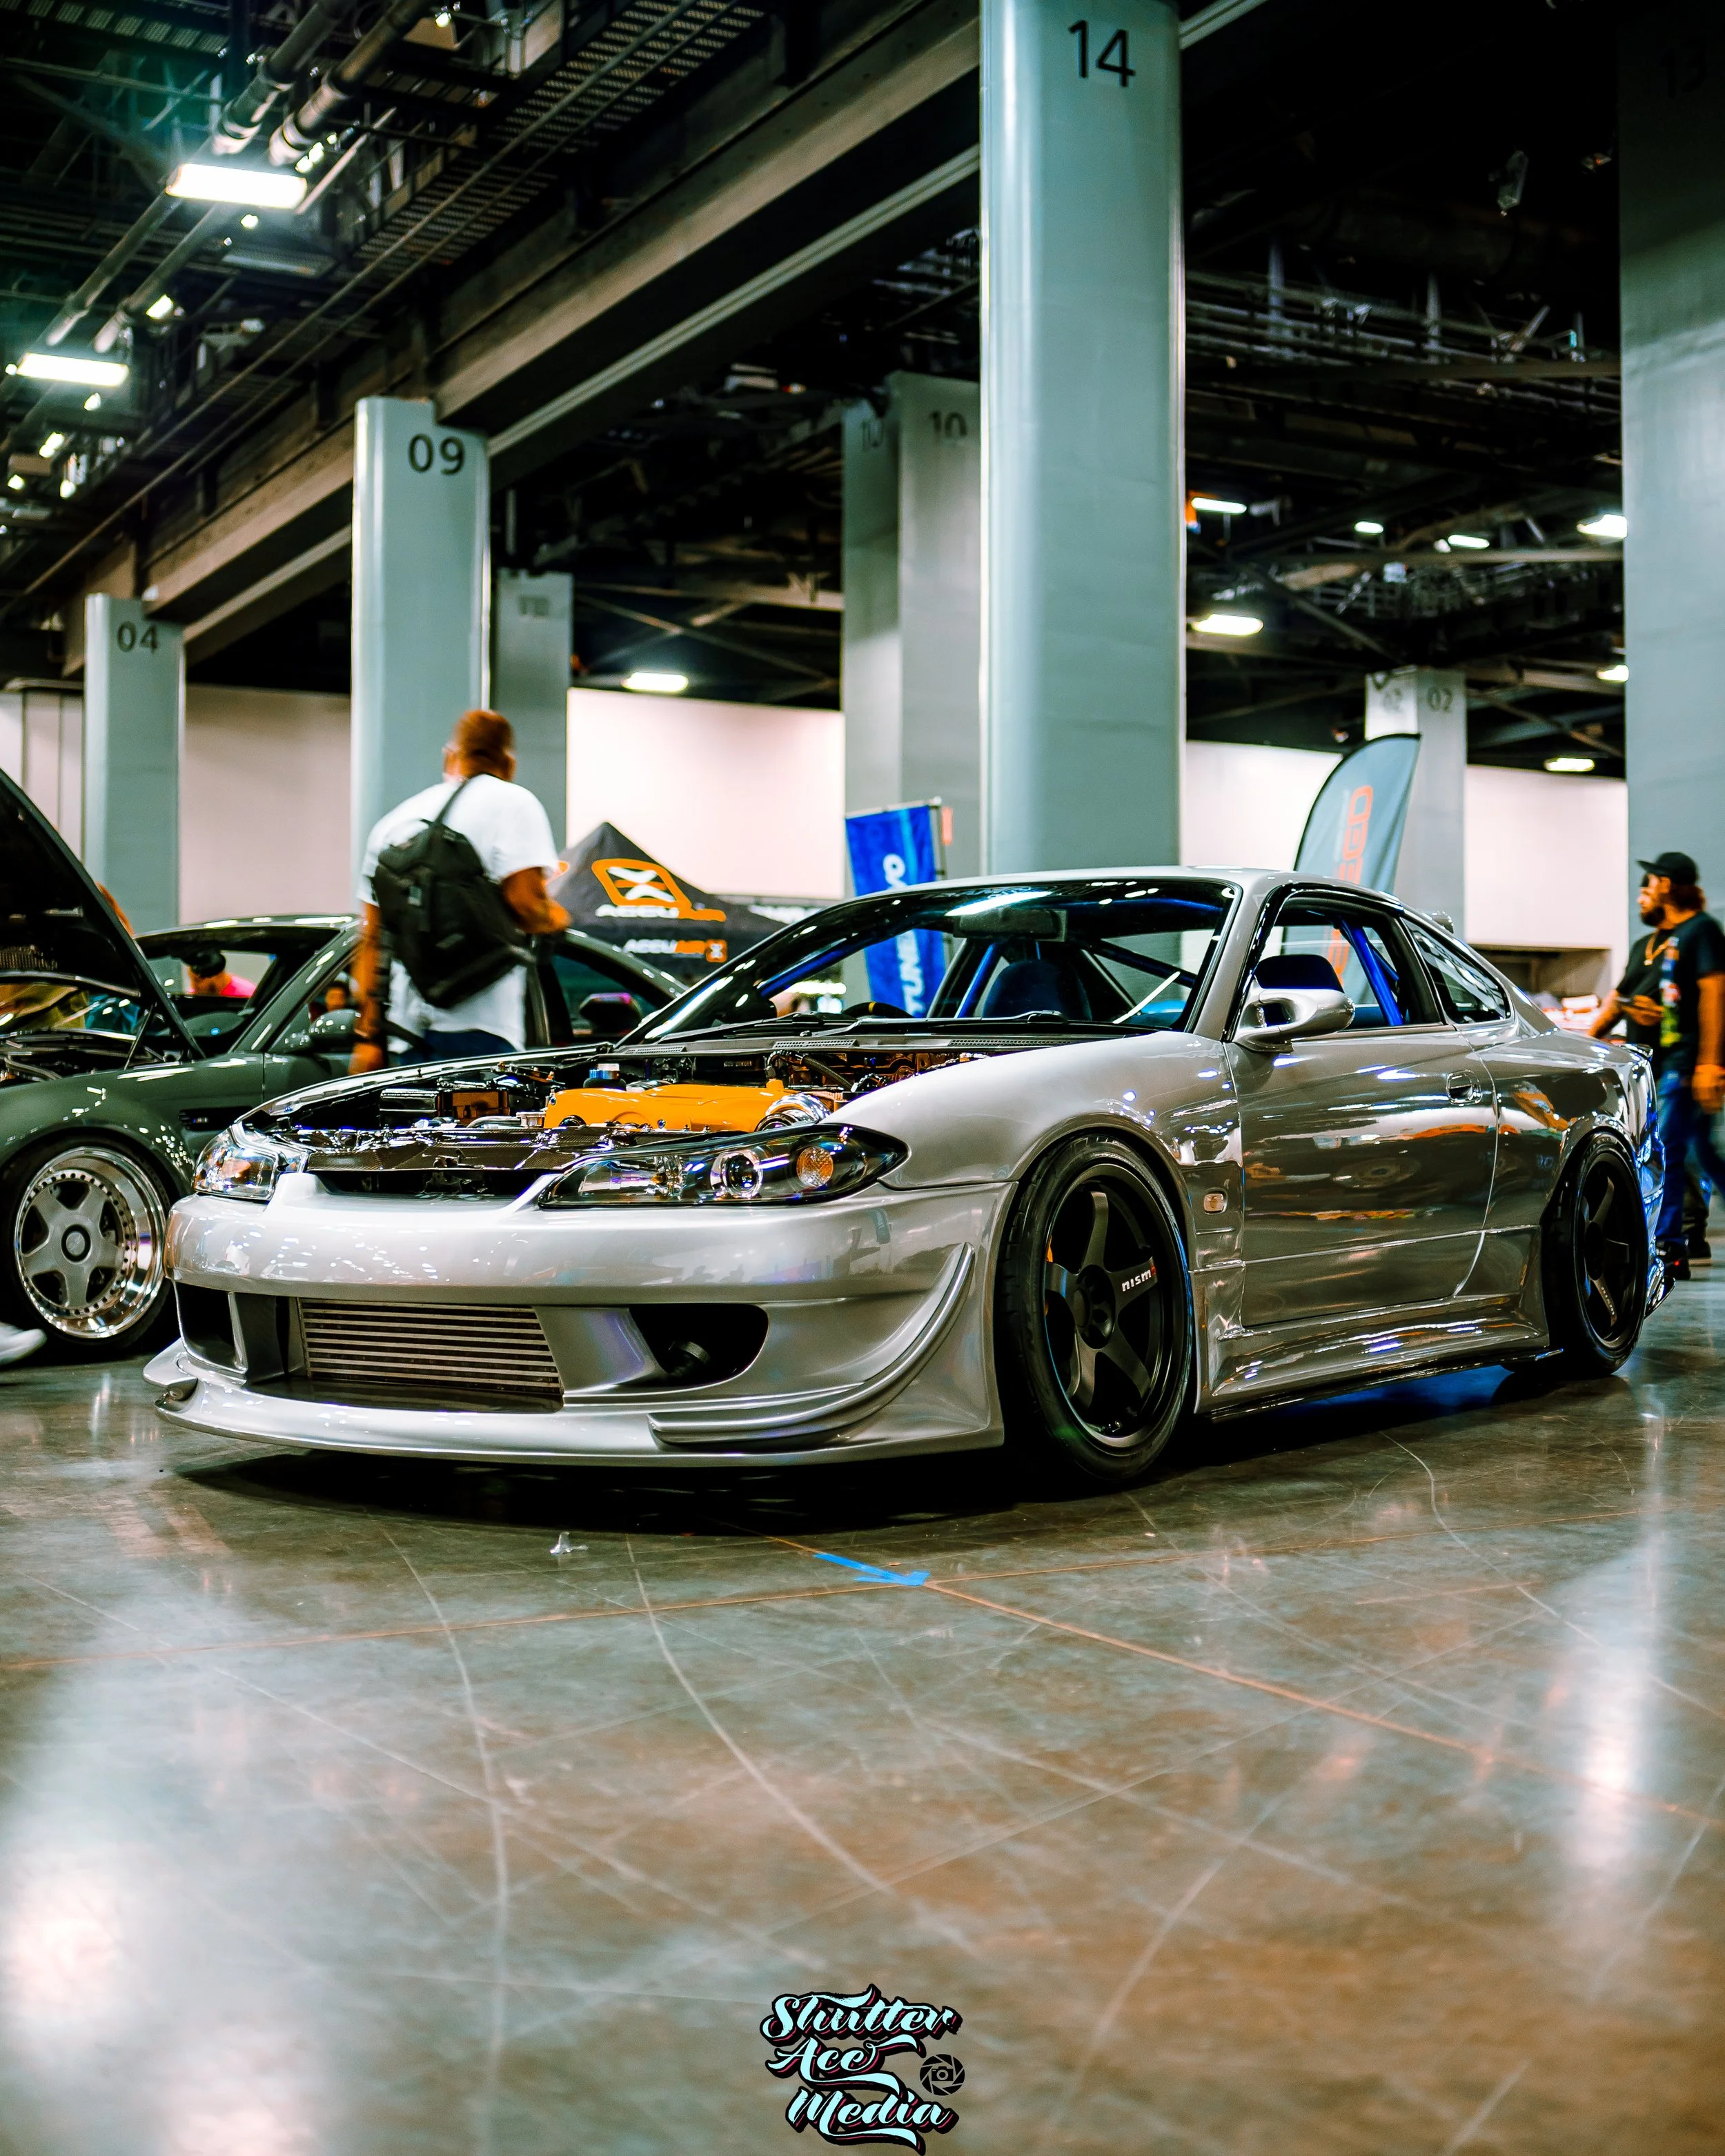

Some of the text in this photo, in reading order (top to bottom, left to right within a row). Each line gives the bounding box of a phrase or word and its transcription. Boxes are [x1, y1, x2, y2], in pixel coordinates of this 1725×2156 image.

[1068, 19, 1136, 88] 14
[408, 433, 465, 475] 09
[117, 621, 158, 655] 04
